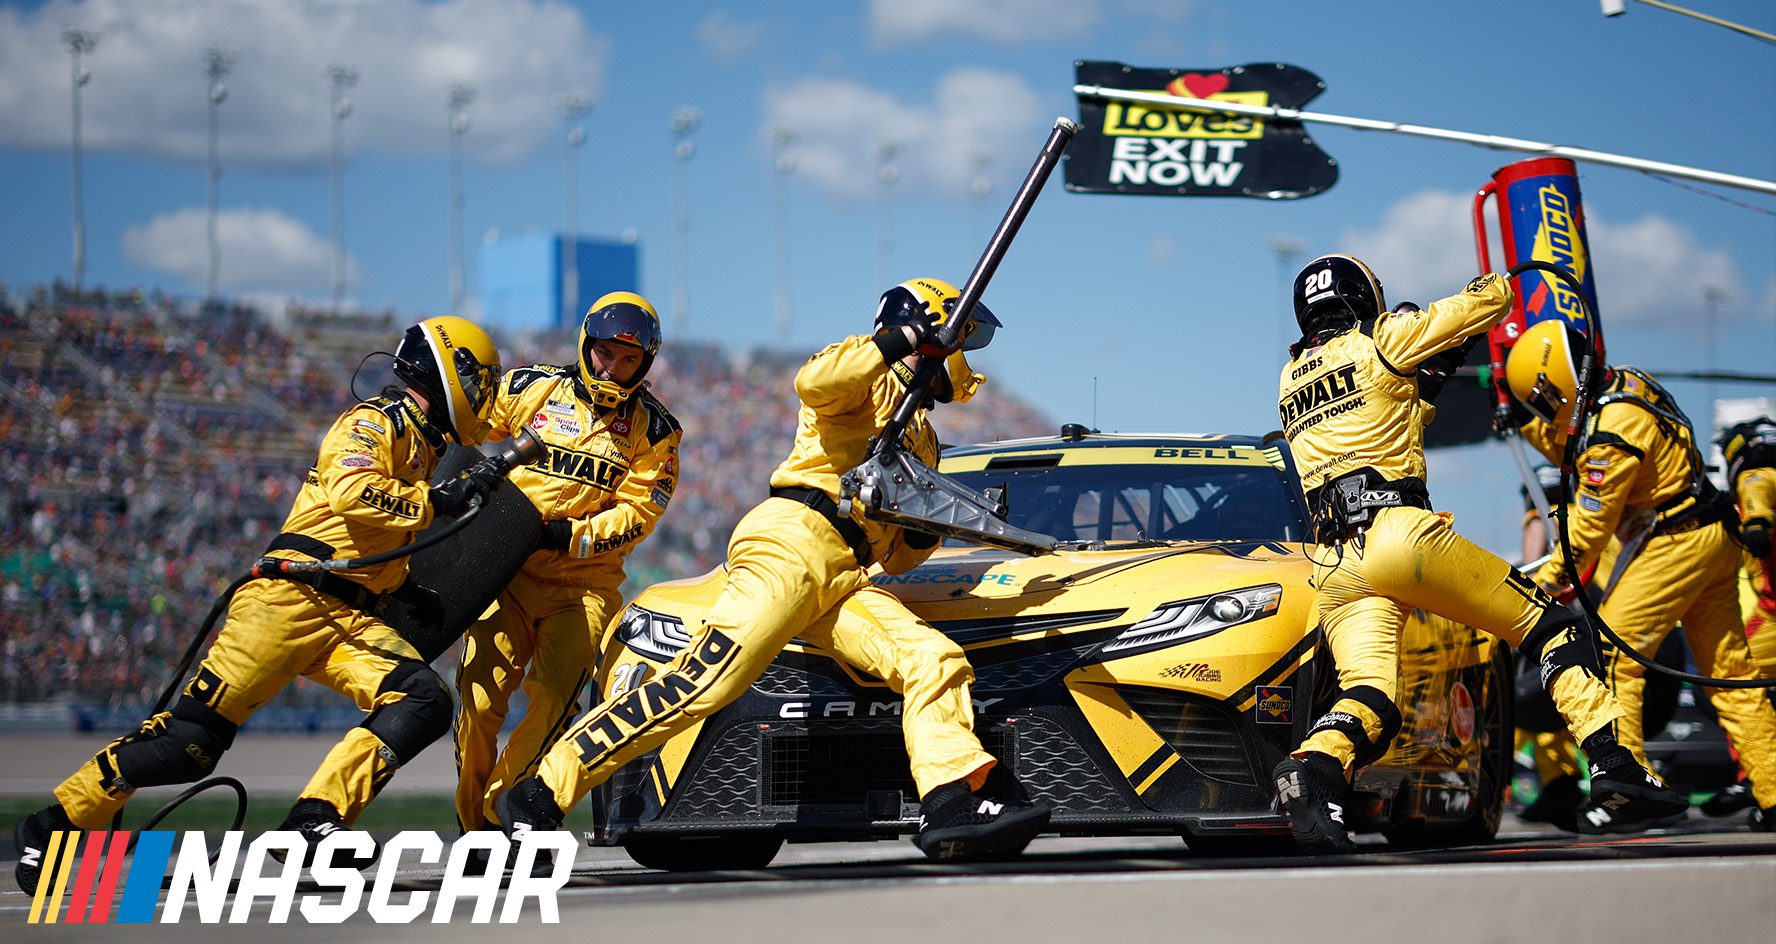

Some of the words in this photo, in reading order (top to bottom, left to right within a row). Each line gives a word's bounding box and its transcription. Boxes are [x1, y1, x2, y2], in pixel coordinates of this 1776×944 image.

[1113, 138, 1247, 163] EXIT
[1109, 161, 1243, 187] NOW
[1305, 269, 1332, 298] 20
[1292, 357, 1323, 380] GIBBS
[1279, 366, 1356, 429] DEWALT
[555, 416, 577, 426] Sport
[560, 424, 580, 433] Clips
[1154, 448, 1249, 460] BELL
[1303, 451, 1356, 480] www.dewalt.com
[537, 449, 625, 488] EWALT
[361, 486, 420, 518] DEWALT
[594, 526, 644, 554] DEWALT
[610, 662, 648, 698] 20
[574, 627, 735, 765] DEWALT
[779, 697, 1004, 718] CAMY
[1260, 701, 1290, 711] SUNOCO
